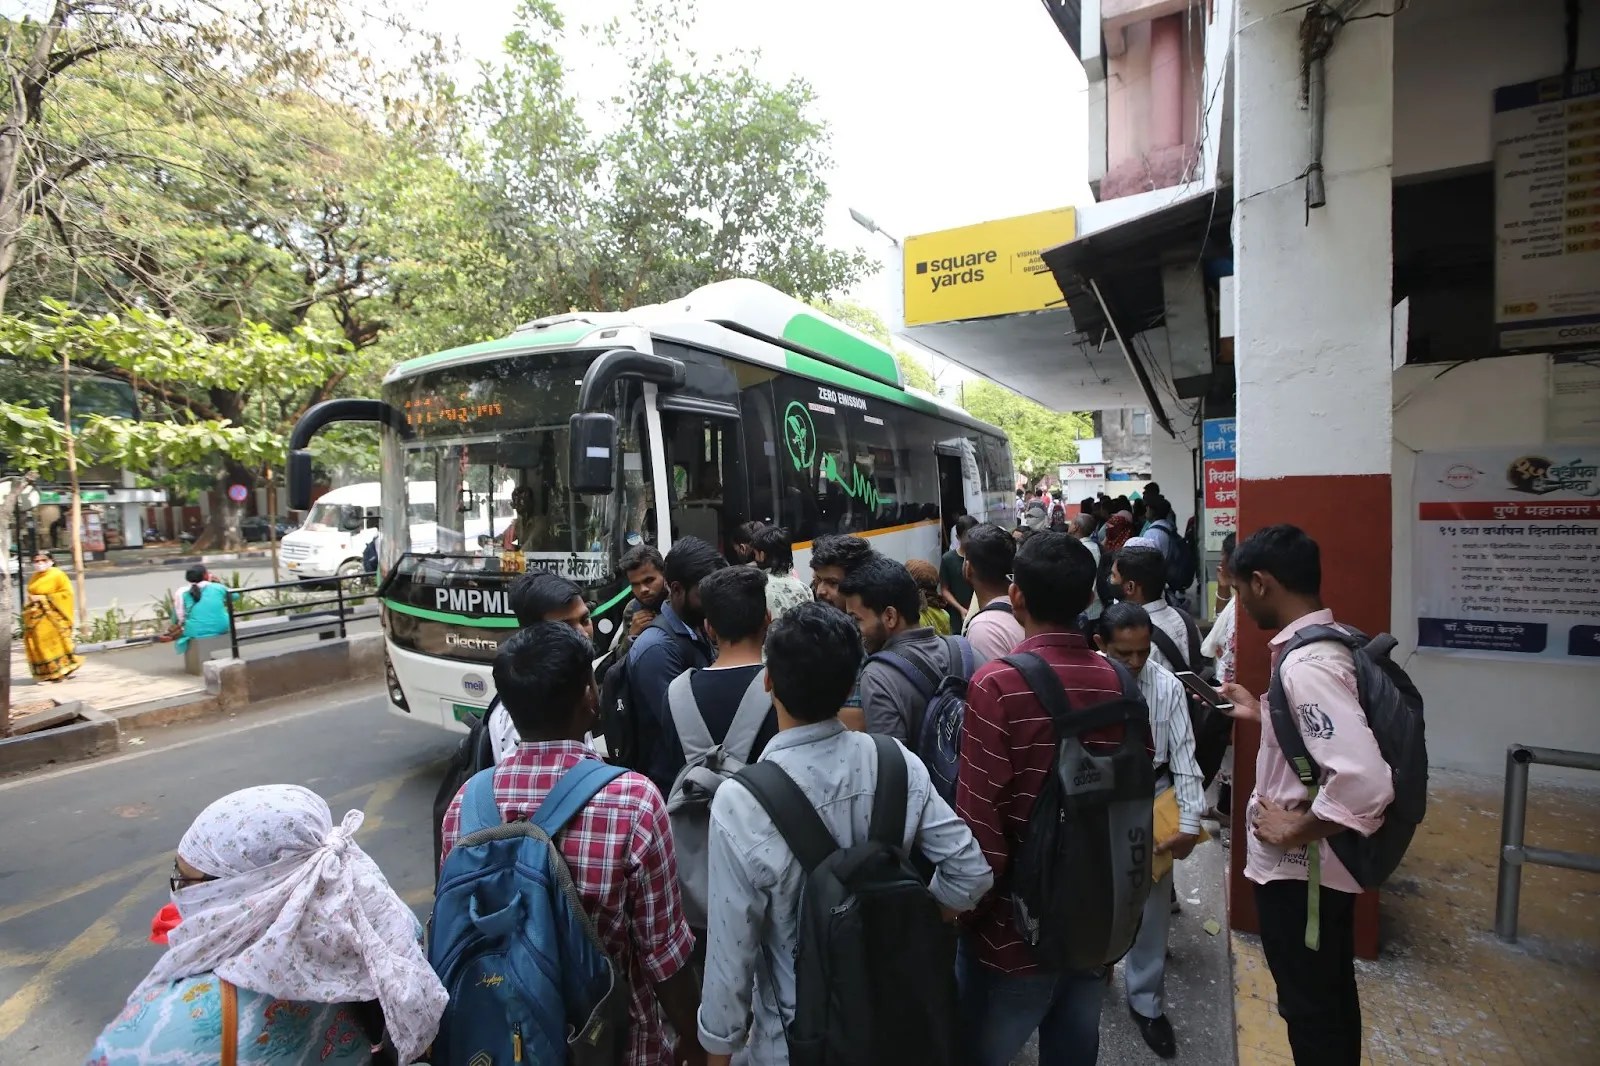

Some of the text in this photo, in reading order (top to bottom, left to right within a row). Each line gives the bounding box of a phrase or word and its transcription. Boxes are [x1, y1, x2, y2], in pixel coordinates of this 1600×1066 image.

[930, 250, 998, 272] square
[931, 267, 985, 293] yards
[818, 386, 837, 404] ZERO
[837, 391, 867, 410] EMISSION
[1492, 503, 1519, 519] पुणे
[1524, 504, 1590, 517] महानगर
[1460, 525, 1479, 536] व्या
[1483, 524, 1524, 537] वर्धापन
[1527, 524, 1597, 537] दिनानिमित्त
[435, 588, 515, 614] PMPML
[464, 678, 484, 692] meil
